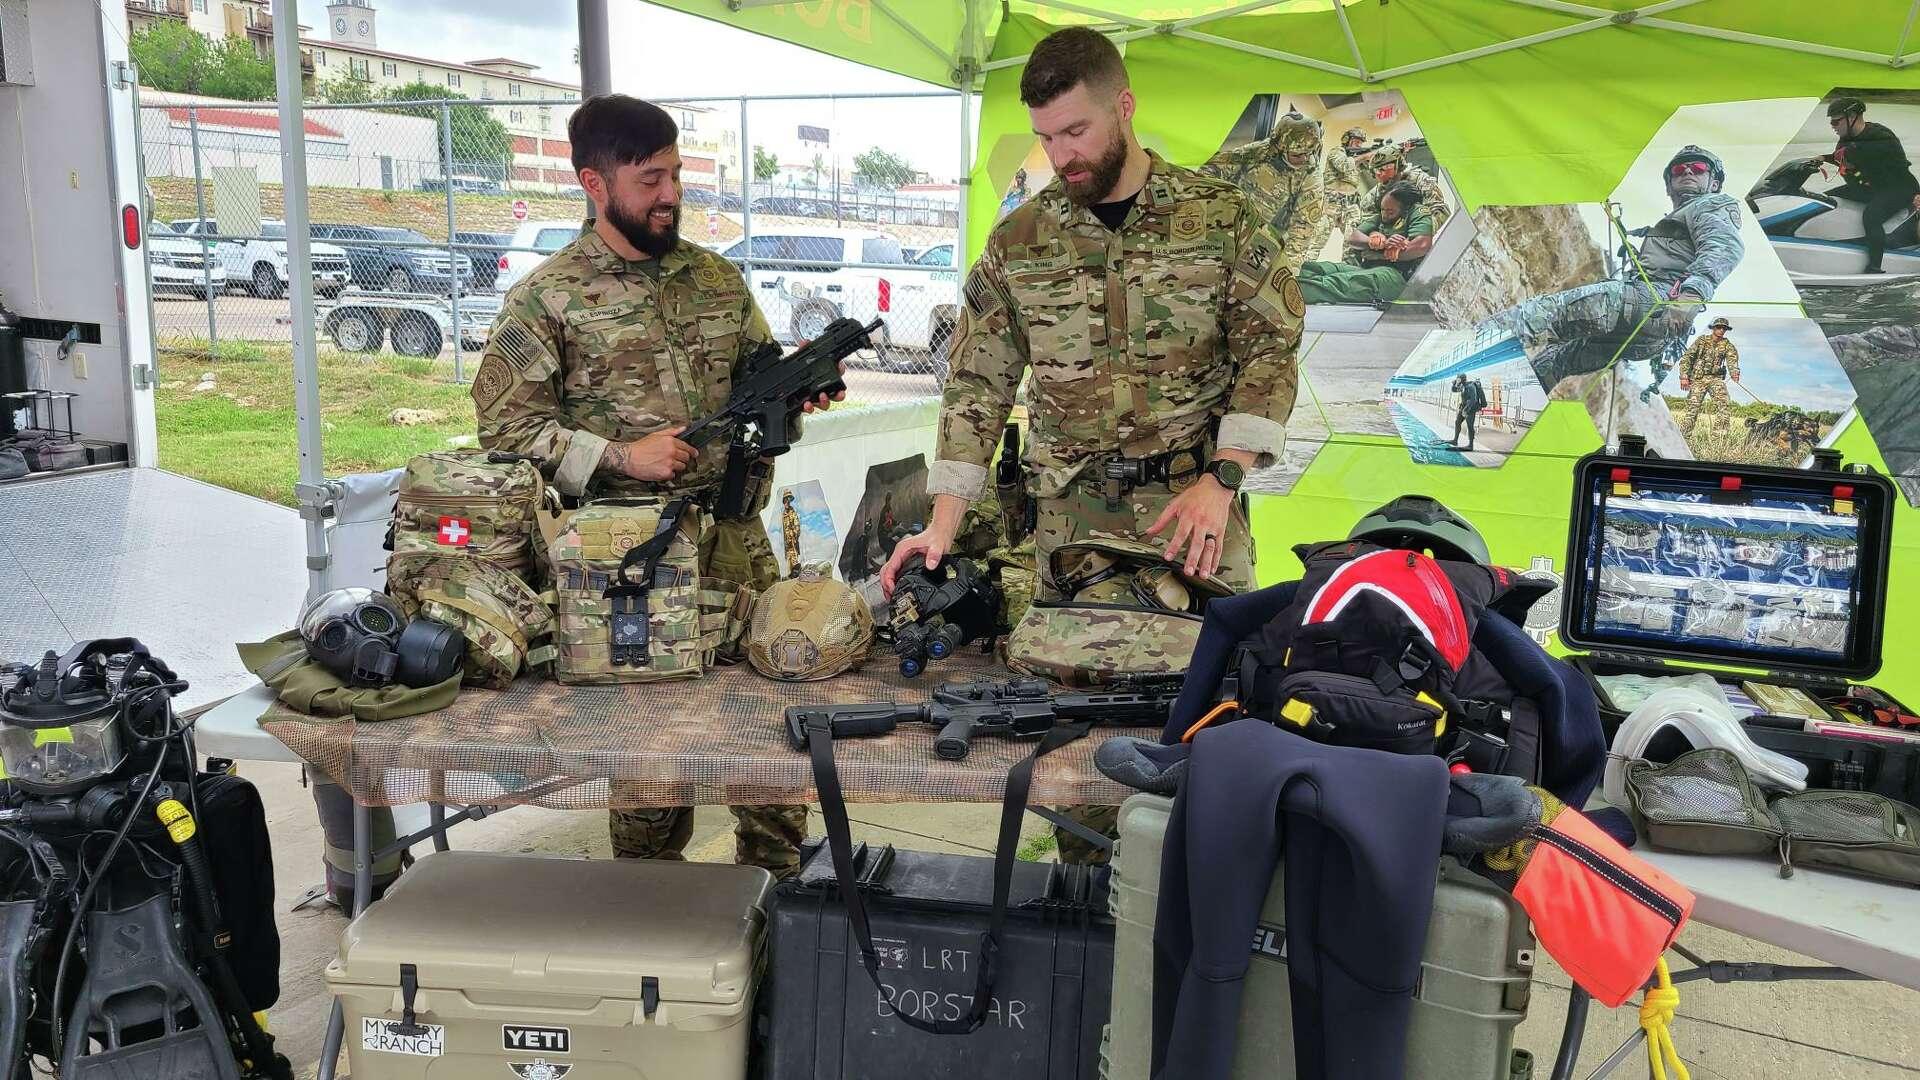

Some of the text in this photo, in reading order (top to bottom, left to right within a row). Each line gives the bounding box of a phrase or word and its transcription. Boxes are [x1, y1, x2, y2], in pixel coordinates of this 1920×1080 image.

[922, 947, 972, 972] LRT
[379, 1036, 442, 1055] RANCH
[506, 1029, 564, 1049] YETI
